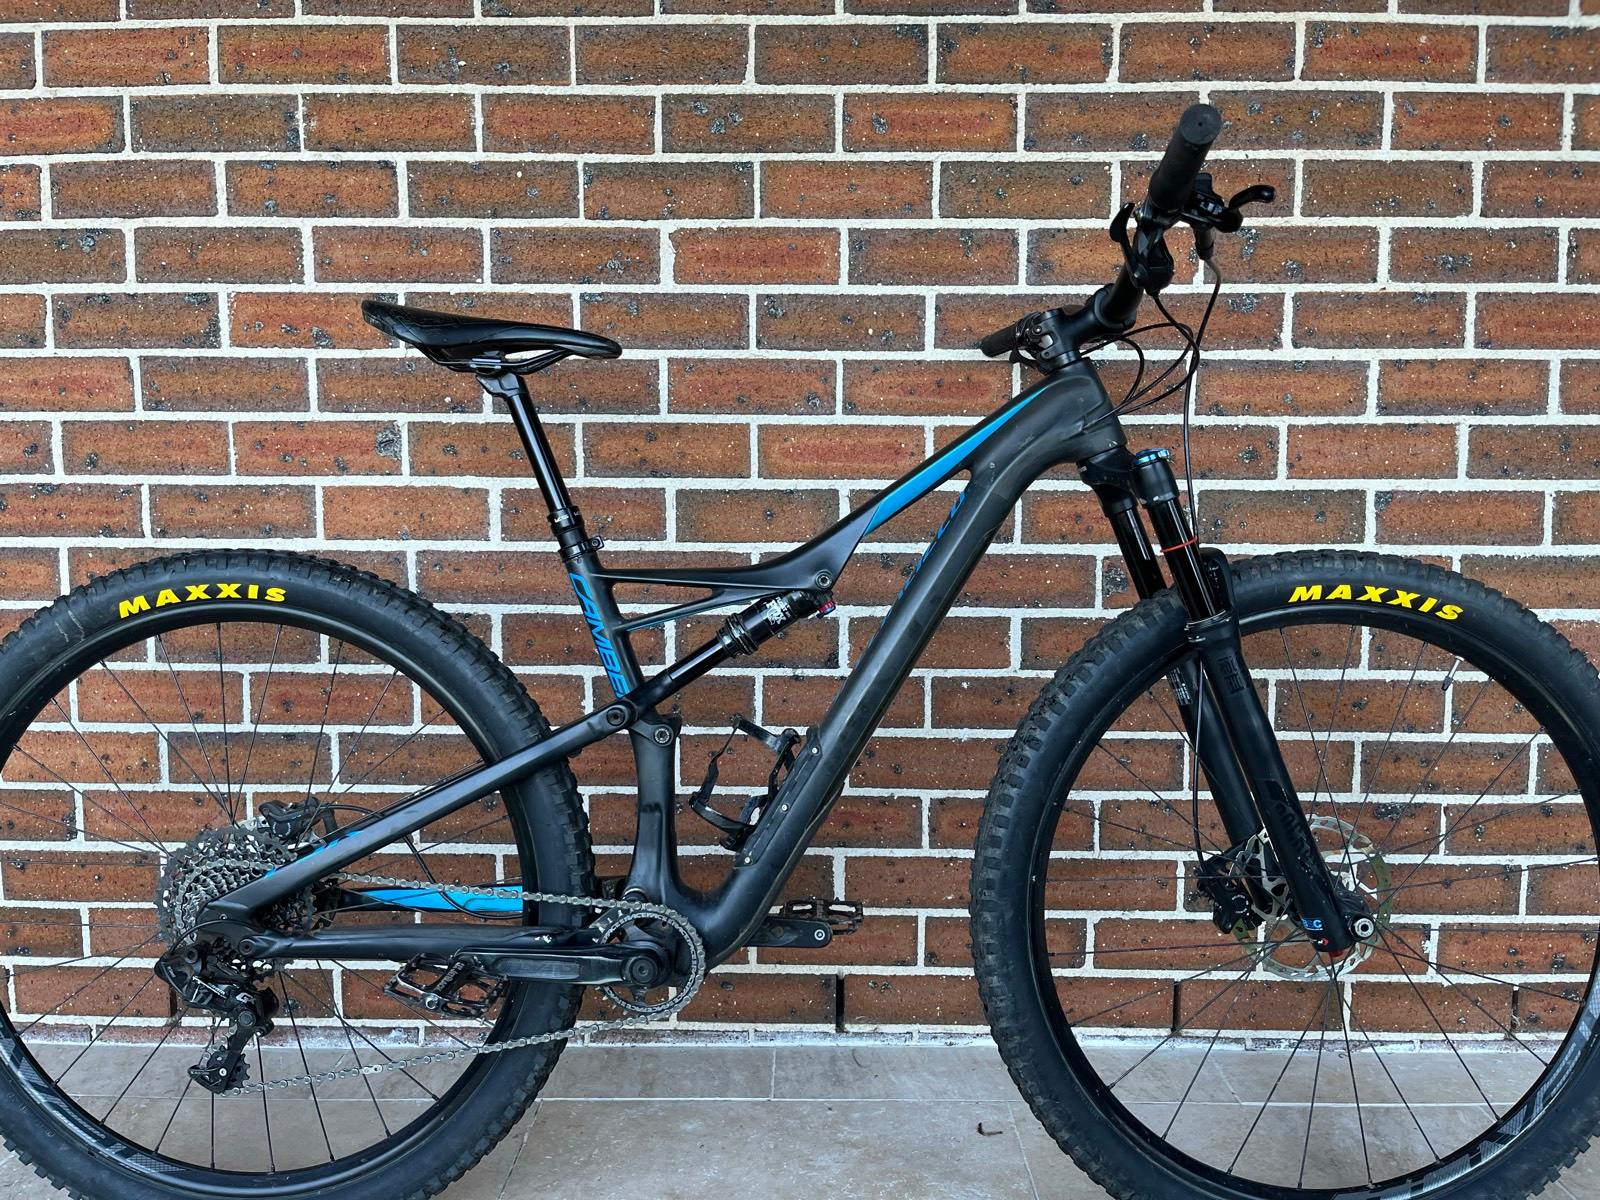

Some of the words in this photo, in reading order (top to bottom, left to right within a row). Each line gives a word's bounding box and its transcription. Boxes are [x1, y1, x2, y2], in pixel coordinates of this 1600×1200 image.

[118, 583, 287, 619] MAXXIS
[1288, 584, 1464, 620] MAXXIS
[570, 573, 631, 698] CAMBE
